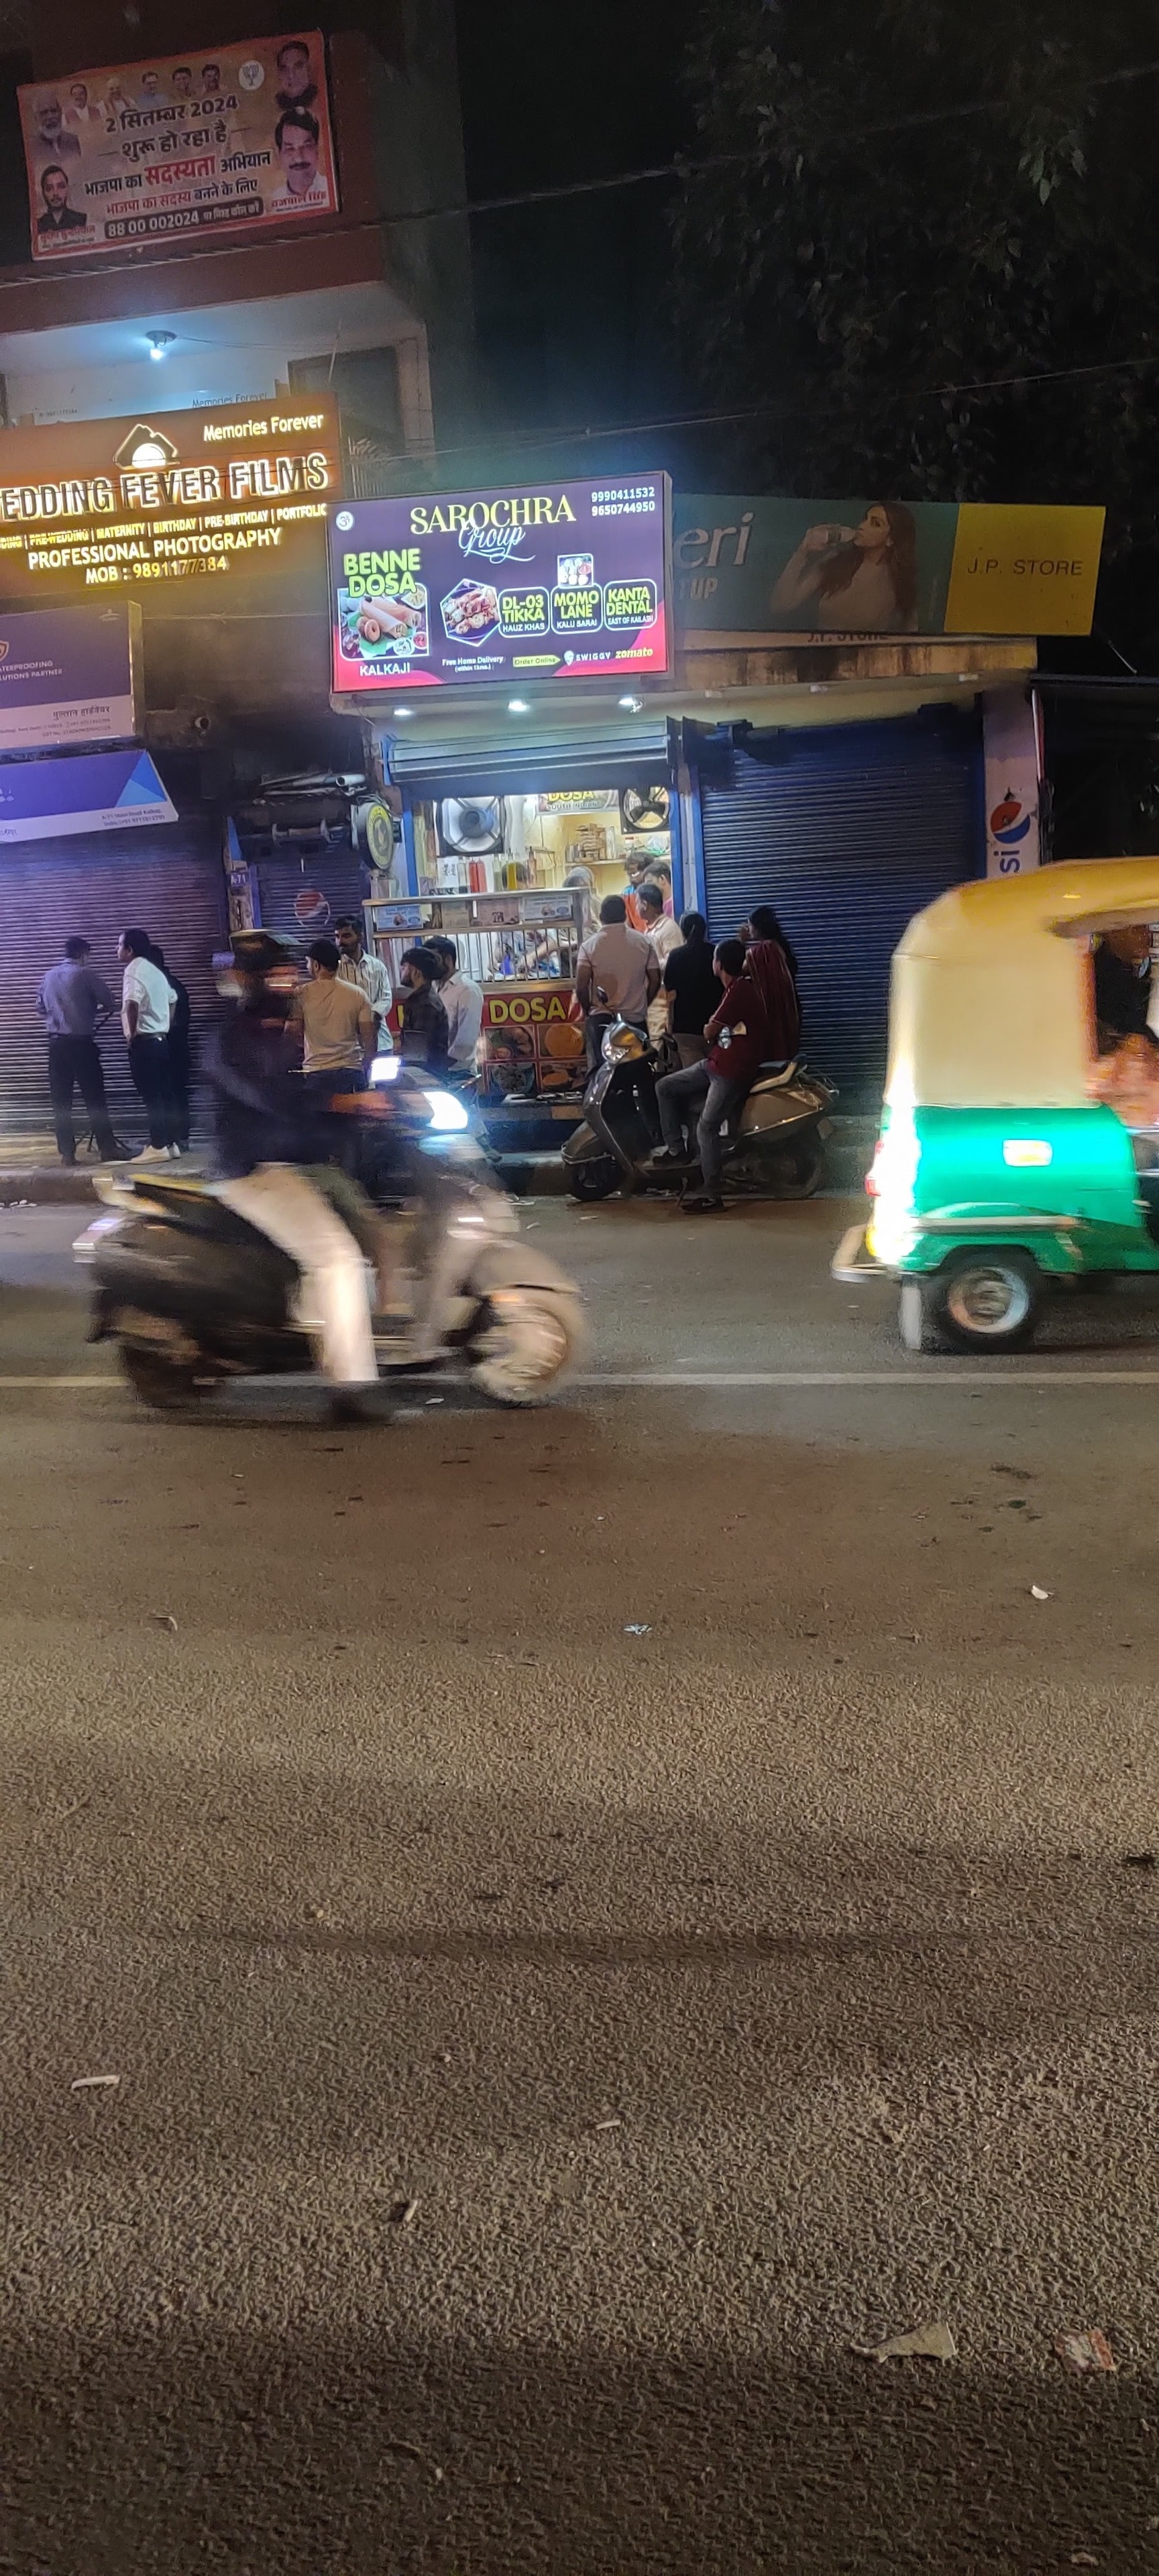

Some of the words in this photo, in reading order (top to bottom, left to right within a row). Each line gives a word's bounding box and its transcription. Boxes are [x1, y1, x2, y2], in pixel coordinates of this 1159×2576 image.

[105, 118, 116, 132] 2
[120, 104, 186, 130] सितम्बर
[190, 95, 237, 117] 2024
[122, 138, 155, 162] शुरू
[159, 130, 178, 152] हो
[181, 128, 210, 146] रहा
[214, 119, 227, 143] है
[85, 178, 122, 195] भाजपा
[124, 174, 142, 187] का
[144, 156, 215, 185] सदस्यता
[221, 152, 271, 172] अभियान
[106, 201, 139, 215] भाजपा
[142, 197, 156, 209] का
[160, 191, 190, 206] सदस्य
[193, 182, 219, 201] बनने
[221, 181, 233, 196] के
[235, 177, 258, 194] लिए
[108, 222, 125, 236] 88
[128, 220, 146, 233] 00
[150, 211, 199, 231] 002024
[204, 420, 267, 441] Memories
[271, 415, 324, 433] Forever
[1, 477, 115, 523] EDDING
[120, 466, 223, 510] FEVER
[229, 452, 329, 499] FILMS
[592, 486, 655, 502] 9990411532
[410, 494, 577, 535] SAROCHRA
[592, 500, 655, 517] 9650744950
[30, 529, 89, 545] PRE-WEDDING
[97, 523, 145, 539] MATERNITY
[153, 517, 197, 534] BIRTHDAY
[205, 510, 268, 529] PRE-BIRTHDAY
[27, 541, 150, 570] PROFESSIONAL
[154, 527, 282, 557] PHOTOGRAPHY
[459, 515, 535, 564] Group
[673, 511, 755, 569] eri
[86, 566, 119, 584] MOB
[133, 555, 227, 579] 9891177384
[343, 548, 421, 576] BENNE
[967, 558, 1003, 575] J.P.
[1013, 559, 1084, 576] STORE
[349, 572, 417, 598] DOSA
[608, 586, 651, 602] KANTA
[502, 594, 544, 610] DL-03
[554, 590, 599, 606] MOMO
[606, 600, 653, 616] DENTAL
[502, 607, 545, 623] TIKKA
[560, 604, 592, 619] LANE
[608, 617, 622, 625] EAST
[622, 616, 630, 625] OF
[630, 616, 653, 624] KAILASH
[503, 624, 523, 633] HAUZ
[525, 623, 545, 631] KHAS
[557, 621, 575, 629] KALU
[576, 619, 597, 628] SARAI
[514, 657, 533, 665] Order
[535, 656, 556, 664] Online
[575, 651, 611, 661] SWIGGY
[615, 648, 653, 659] zomato
[360, 662, 410, 676] KALKAJI
[489, 996, 567, 1024] DOSA
